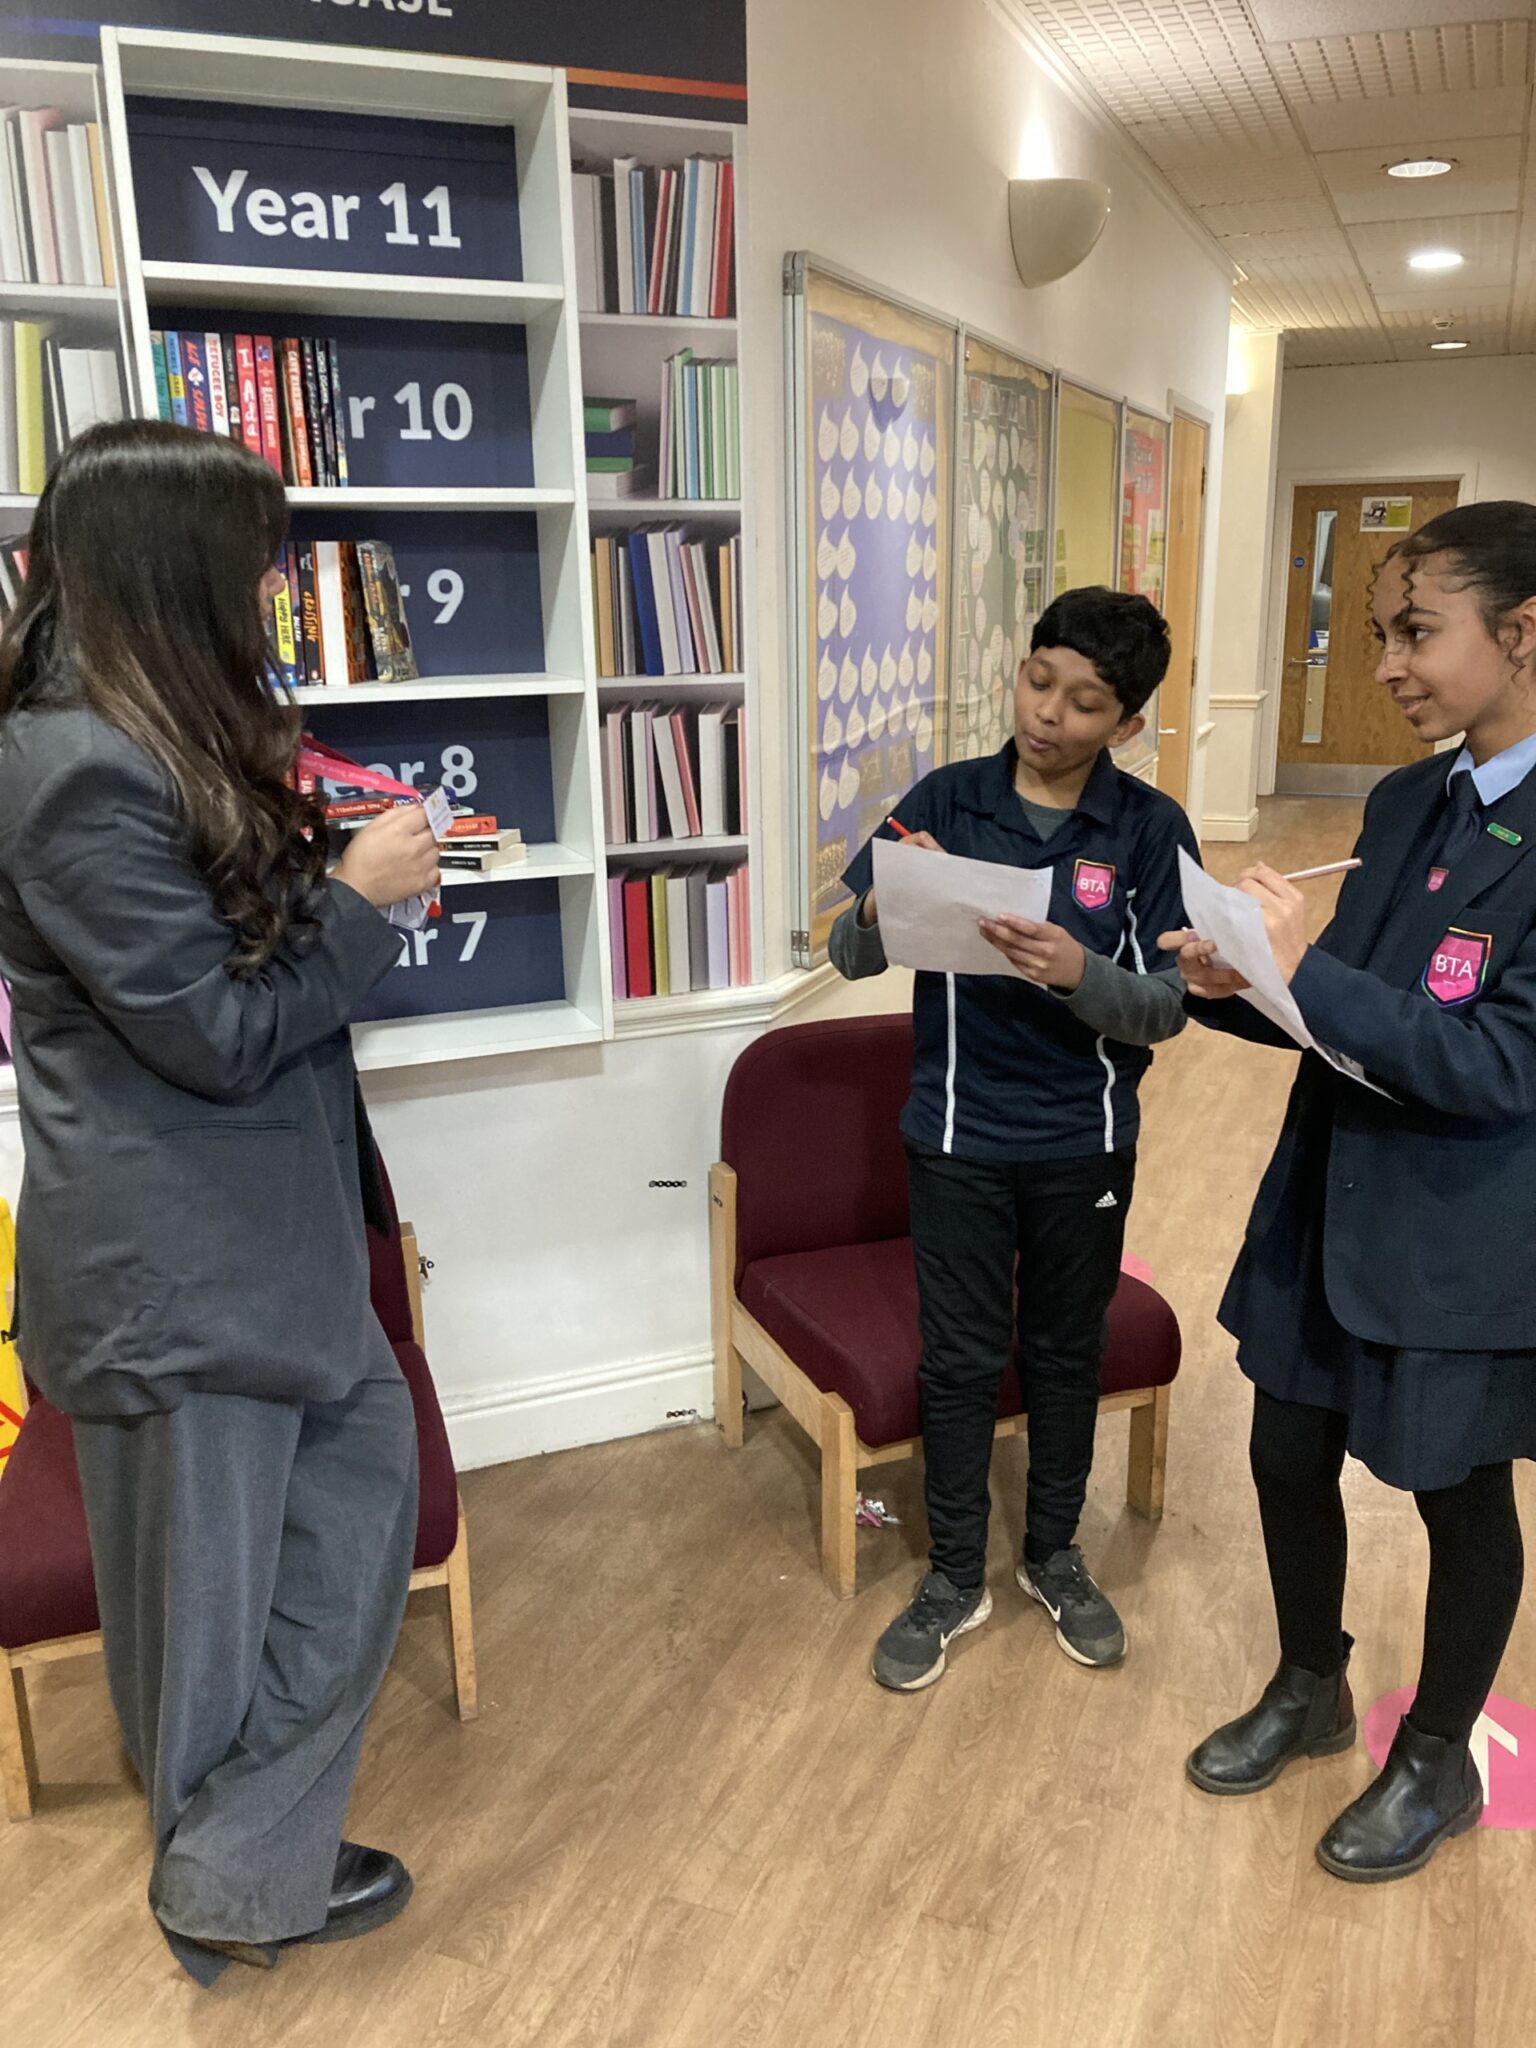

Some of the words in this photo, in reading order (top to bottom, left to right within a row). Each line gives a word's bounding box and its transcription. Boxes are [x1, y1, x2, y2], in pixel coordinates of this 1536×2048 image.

[191, 166, 360, 240] Year
[378, 182, 461, 248] 11
[213, 395, 225, 417] BOY
[393, 382, 473, 441] 10
[427, 568, 464, 624] 9
[440, 744, 478, 797] 8
[1080, 877, 1106, 894] BTA
[452, 911, 487, 962] 7
[1435, 953, 1474, 979] BTA
